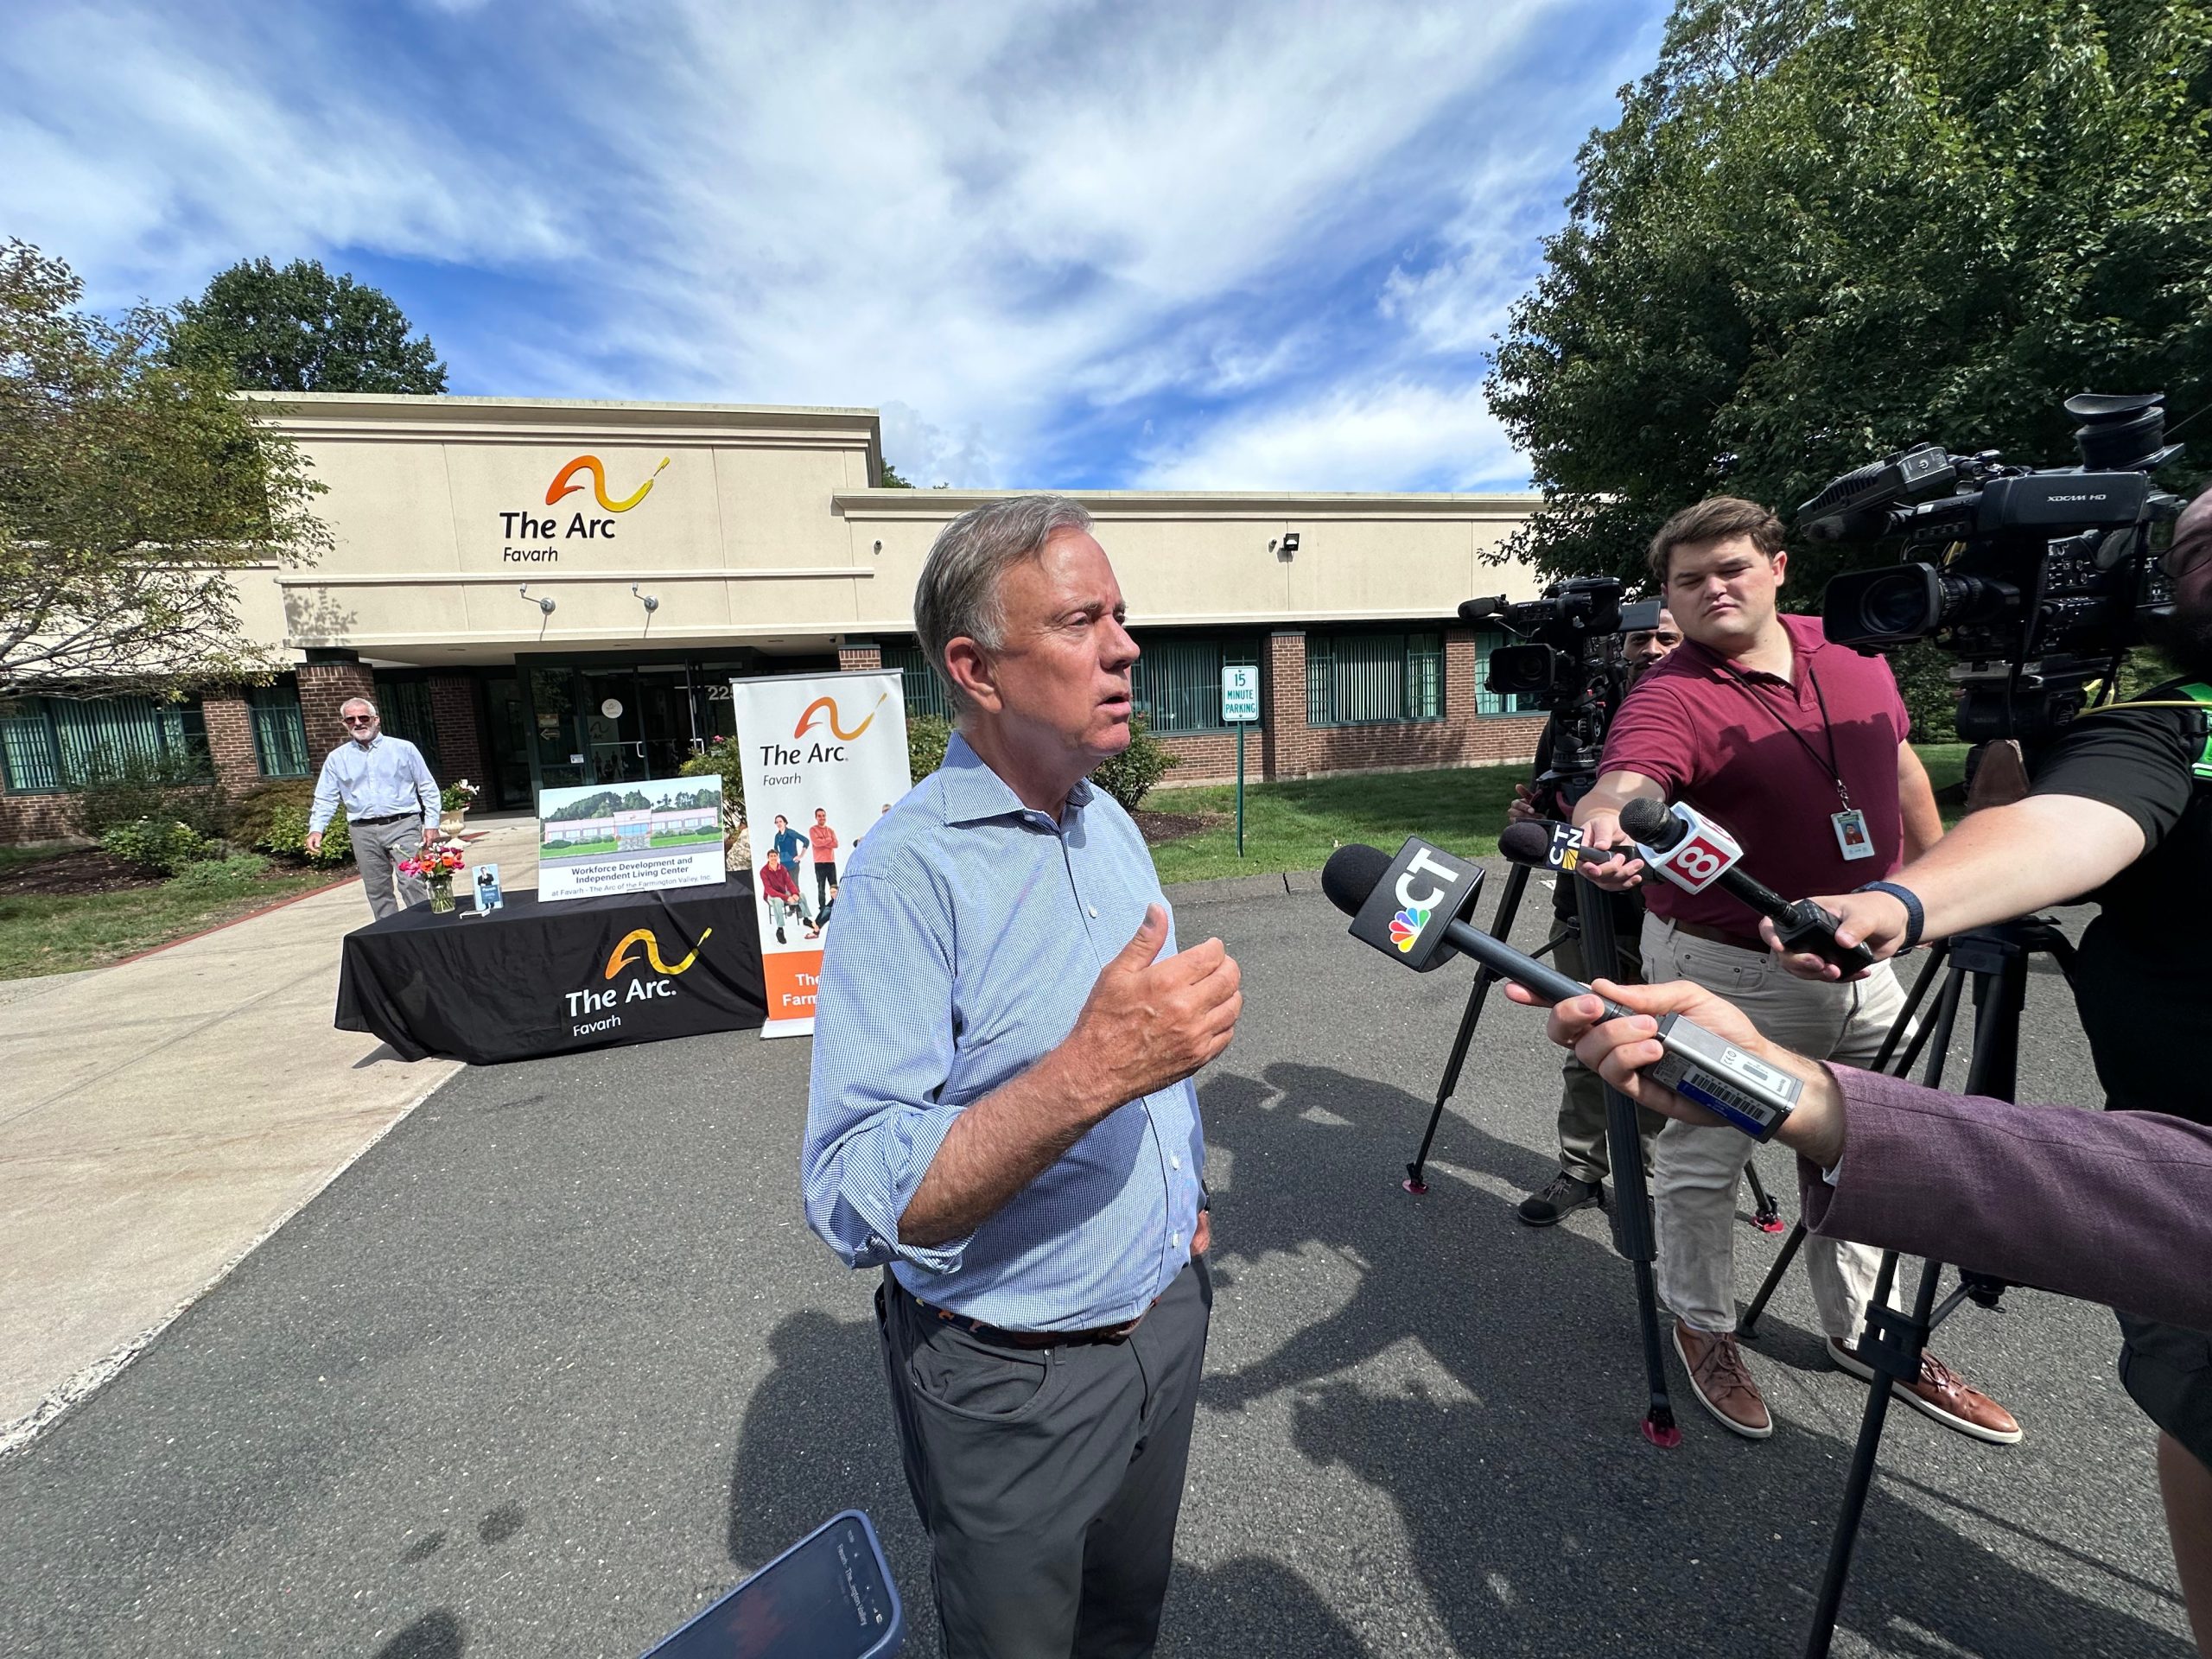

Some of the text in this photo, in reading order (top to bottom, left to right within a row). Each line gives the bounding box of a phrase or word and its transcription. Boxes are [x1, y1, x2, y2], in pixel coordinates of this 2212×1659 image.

[499, 512, 616, 539] The Arc
[503, 546, 558, 563] Favarh
[1235, 673, 1246, 687] 15
[708, 685, 734, 701] 22
[1227, 690, 1254, 700] MINUTE
[1225, 702, 1255, 714] PARKING
[760, 744, 801, 766] The
[763, 772, 802, 786] Favarh
[571, 856, 693, 875] Workforce Development and
[1677, 846, 1719, 879] 8
[575, 866, 690, 884] Independent Living Center
[1395, 847, 1459, 911] CT
[560, 887, 584, 896] Favarh
[639, 878, 677, 887] Farmington
[565, 988, 617, 1017] The
[573, 1014, 621, 1037] Favarh
